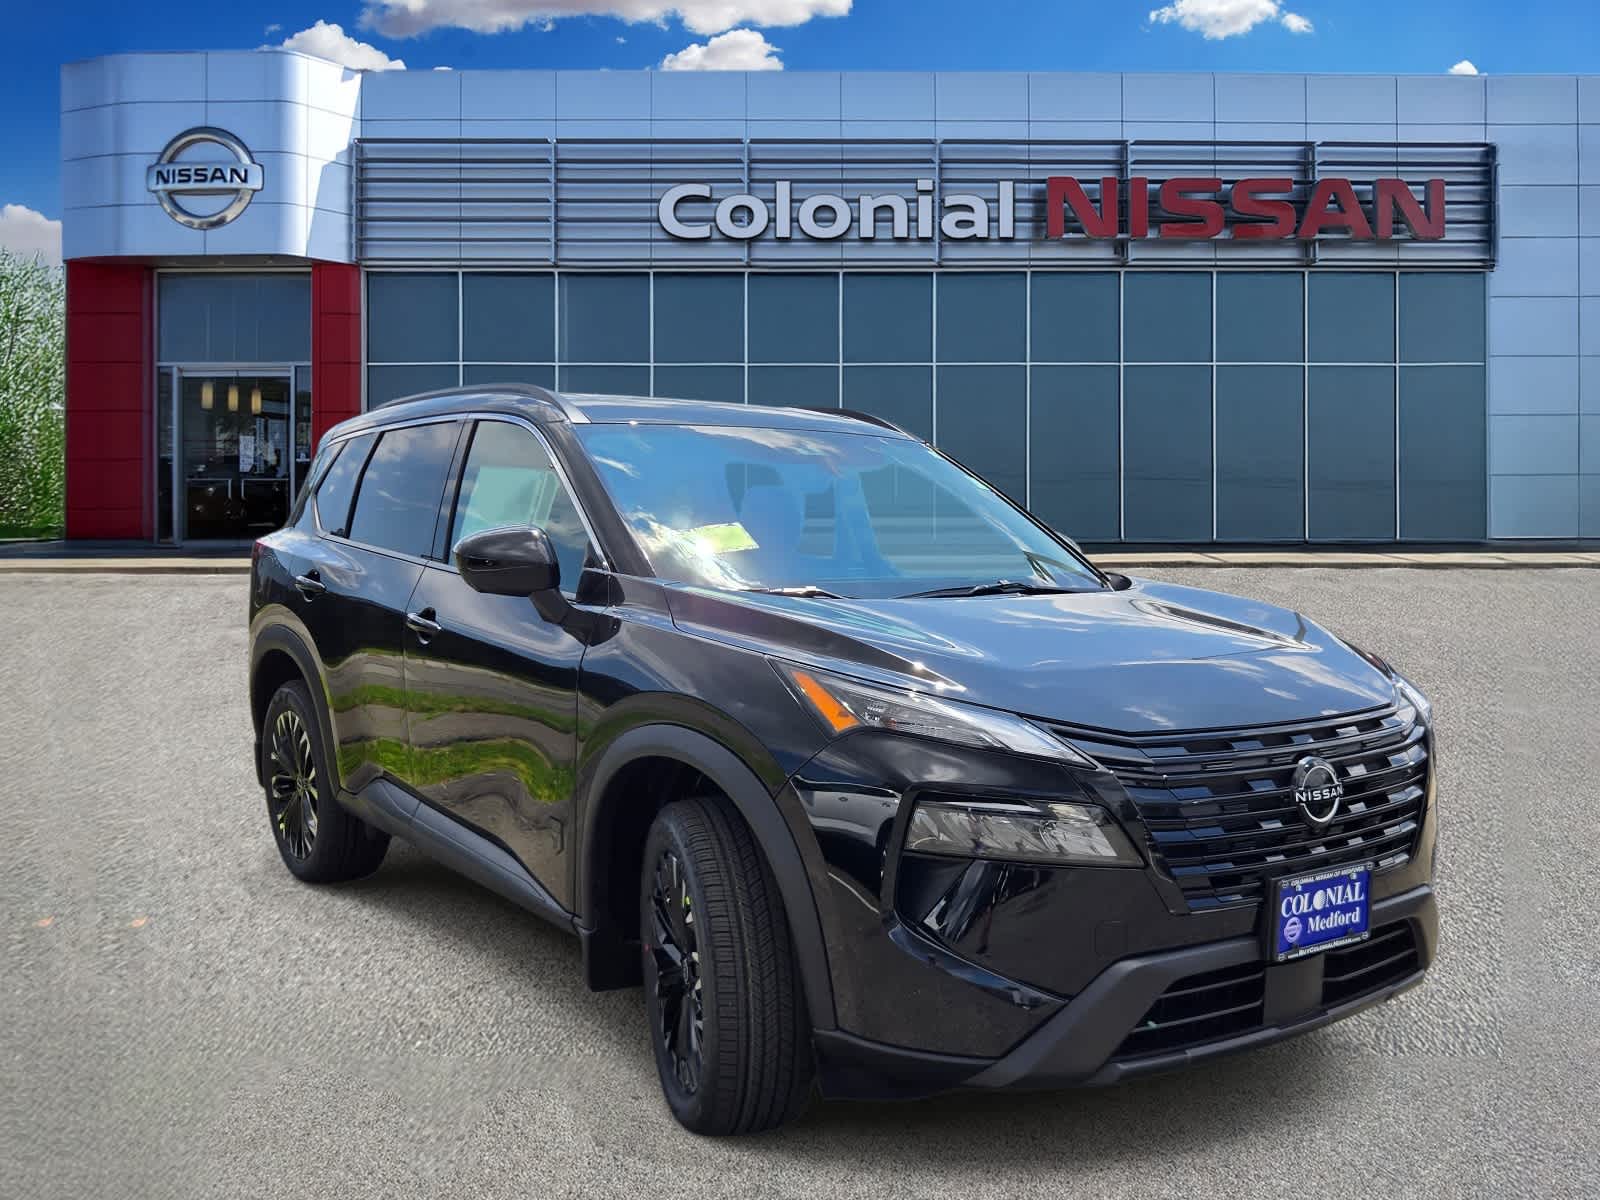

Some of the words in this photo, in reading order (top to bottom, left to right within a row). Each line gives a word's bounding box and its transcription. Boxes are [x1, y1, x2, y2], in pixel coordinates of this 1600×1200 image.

[156, 168, 248, 185] NISSAN
[658, 180, 1014, 239] Colonial
[1046, 177, 1445, 240] NISSAN
[1296, 785, 1343, 802] NISSAN
[1281, 882, 1364, 918] COLONIAL
[1308, 907, 1360, 934] Medford
